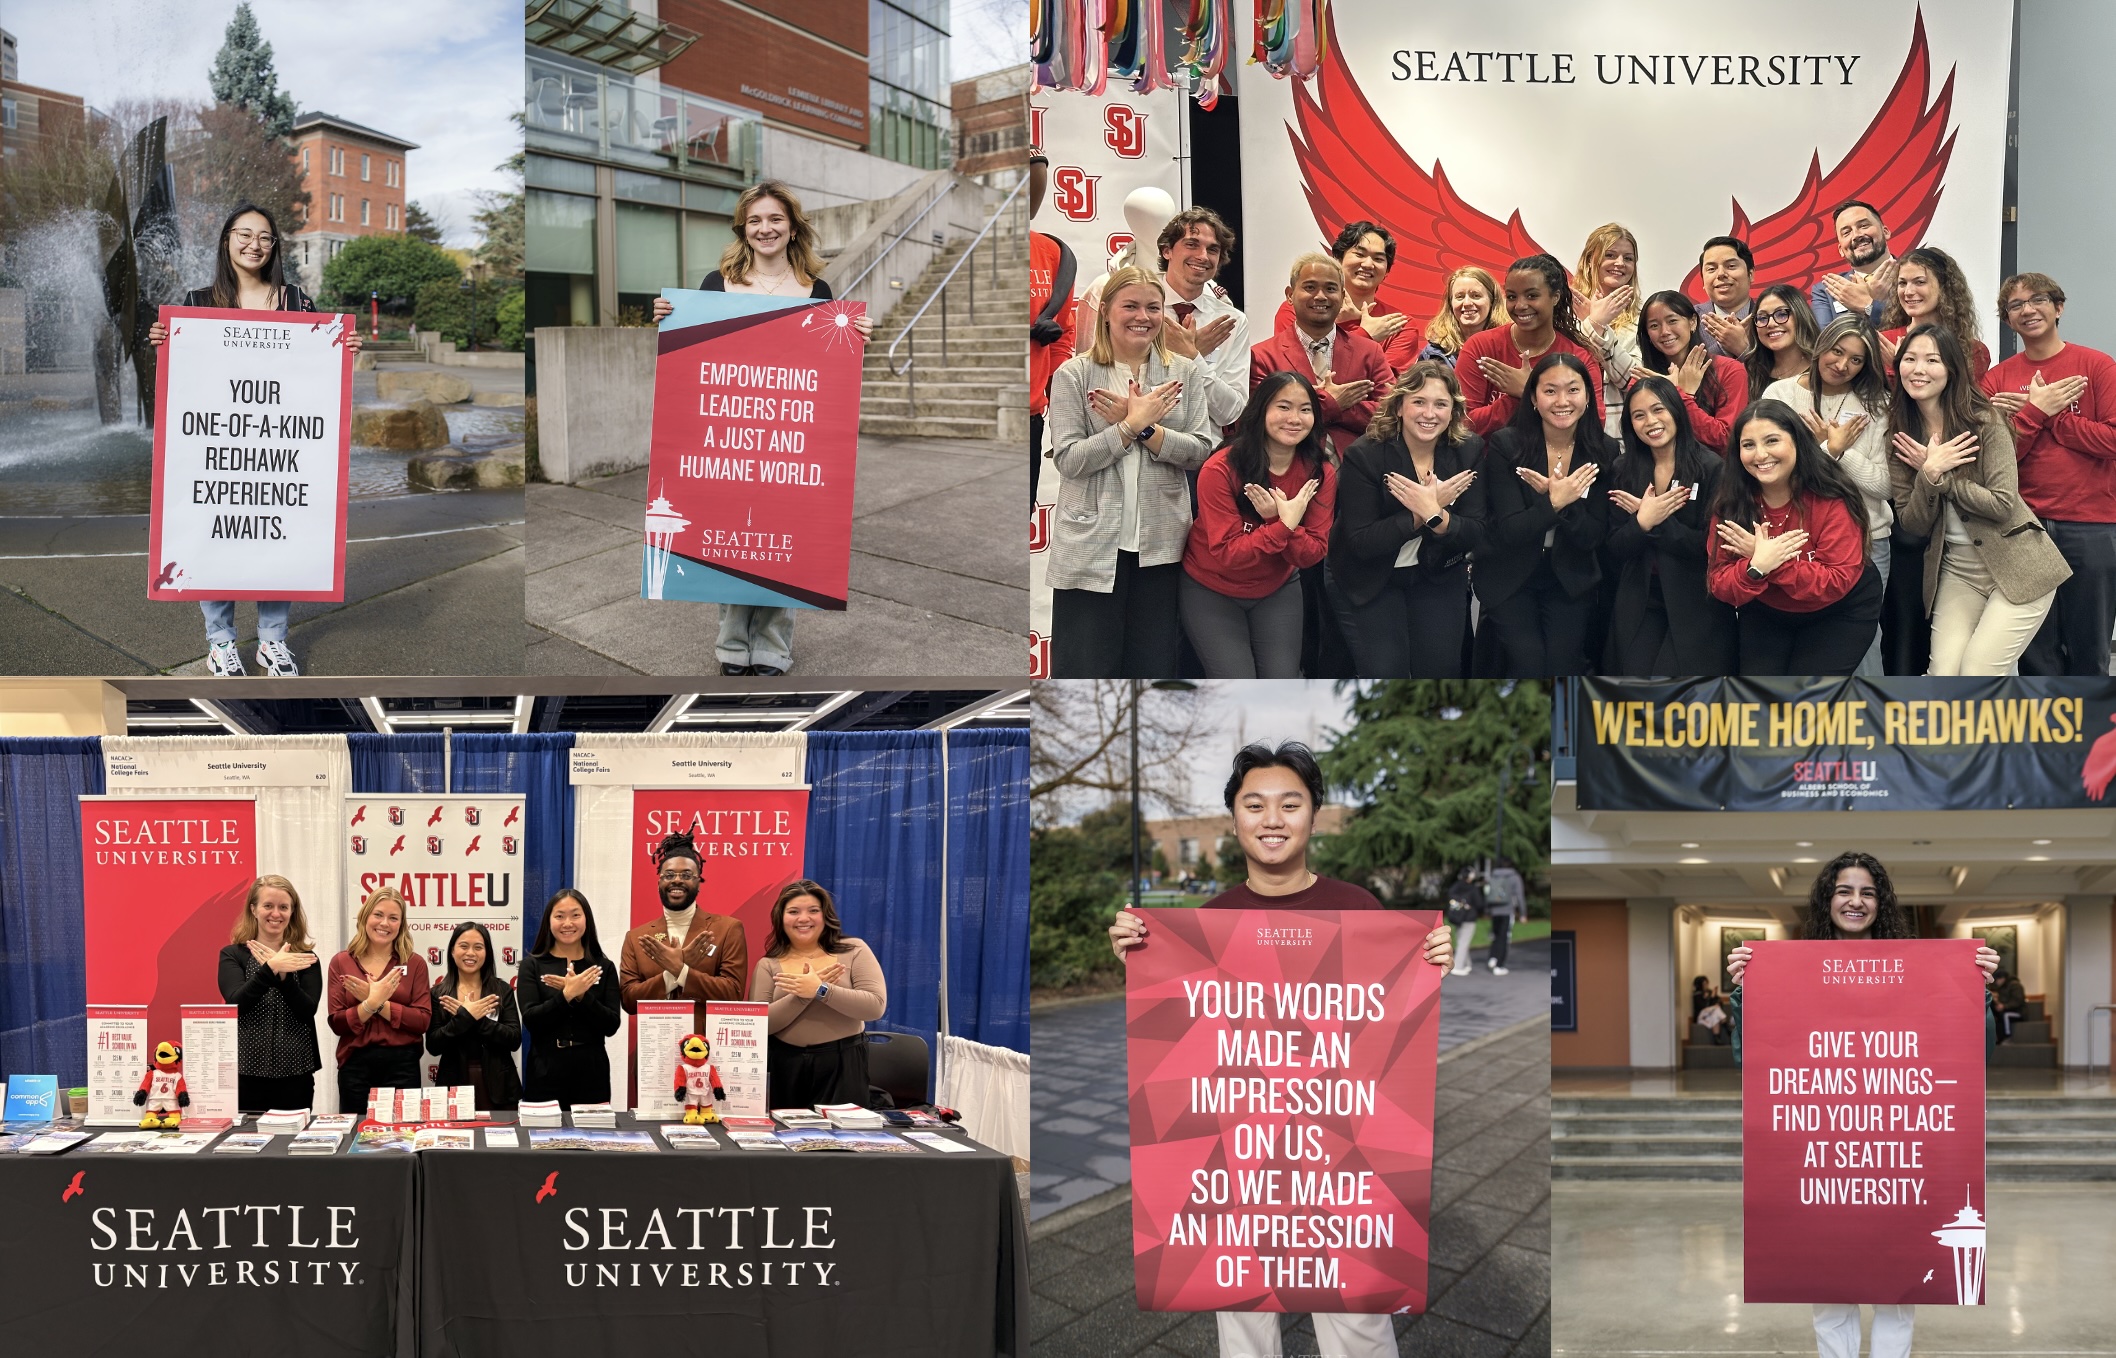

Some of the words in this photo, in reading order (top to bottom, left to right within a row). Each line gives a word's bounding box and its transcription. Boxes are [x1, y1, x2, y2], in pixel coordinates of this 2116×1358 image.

[1392, 49, 1576, 85] SEATTLE
[1594, 53, 1861, 88] UNIVERSITY
[223, 326, 291, 341] SEATTLE
[223, 340, 291, 350] UNIVERSITY
[700, 361, 818, 392] EMPOWERING
[230, 379, 281, 405] YOUR
[700, 394, 777, 422] LEADERS
[780, 398, 815, 423] FOR
[181, 411, 324, 440] ONE-OF-A-KIND
[704, 425, 716, 448] A
[719, 426, 766, 451] JUST
[768, 430, 805, 454] AND
[205, 447, 299, 473] REDHAWK
[679, 455, 754, 482] HUMANE
[759, 460, 825, 487] WORLD.
[193, 480, 309, 507] EXPERIENCE
[211, 515, 287, 541] AWAITS.
[703, 529, 793, 550] SEATTLE
[702, 548, 793, 563] UNIVERSITY
[1592, 699, 1760, 747] WELCOME
[1770, 700, 1874, 751] HOME,
[1885, 697, 2083, 746] REDHAWKS!
[232, 762, 267, 770] University
[698, 760, 732, 768] University
[1781, 790, 1819, 798] BUSINESS
[1798, 783, 1826, 791] ALBERS
[95, 819, 240, 845] SEATTLE
[646, 810, 791, 836] SEATTLE
[1257, 928, 1313, 939] SEATTLE
[1822, 959, 1905, 973] SEATTLE
[1823, 975, 1905, 985] UNIVERSITY
[1183, 980, 1264, 1020] YOUR
[1273, 982, 1385, 1022] WORDS
[97, 1031, 109, 1050] #1
[716, 1027, 728, 1046] #1
[1217, 1030, 1302, 1068] MADE
[1310, 1032, 1350, 1068] AN
[1809, 1030, 1855, 1058] GIVE
[1861, 1030, 1919, 1058] YOUR
[160, 1083, 168, 1093] 6
[695, 1078, 703, 1088] 6
[1769, 1067, 1857, 1095] DREAMS
[1191, 1077, 1375, 1116] IMPRESSION
[1772, 1104, 1820, 1132] FIND
[1826, 1104, 1883, 1132] YOUR
[1889, 1104, 1955, 1132] PLACE
[1234, 1124, 1274, 1160] ON
[1285, 1125, 1331, 1165] US,
[1804, 1141, 1830, 1169] AT
[1834, 1141, 1923, 1169] SEATTLE
[1191, 1169, 1229, 1205] SO
[1238, 1169, 1282, 1205] WE
[1291, 1171, 1374, 1206] MADE
[1800, 1178, 1927, 1206] UNIVERSITY.
[91, 1205, 359, 1251] SEATTLE
[563, 1207, 836, 1251] SEATTLE
[1169, 1213, 1206, 1246] AN
[1217, 1213, 1393, 1249] IMPRESSION
[1216, 1255, 1250, 1288] OF
[1259, 1256, 1346, 1289] THEM.
